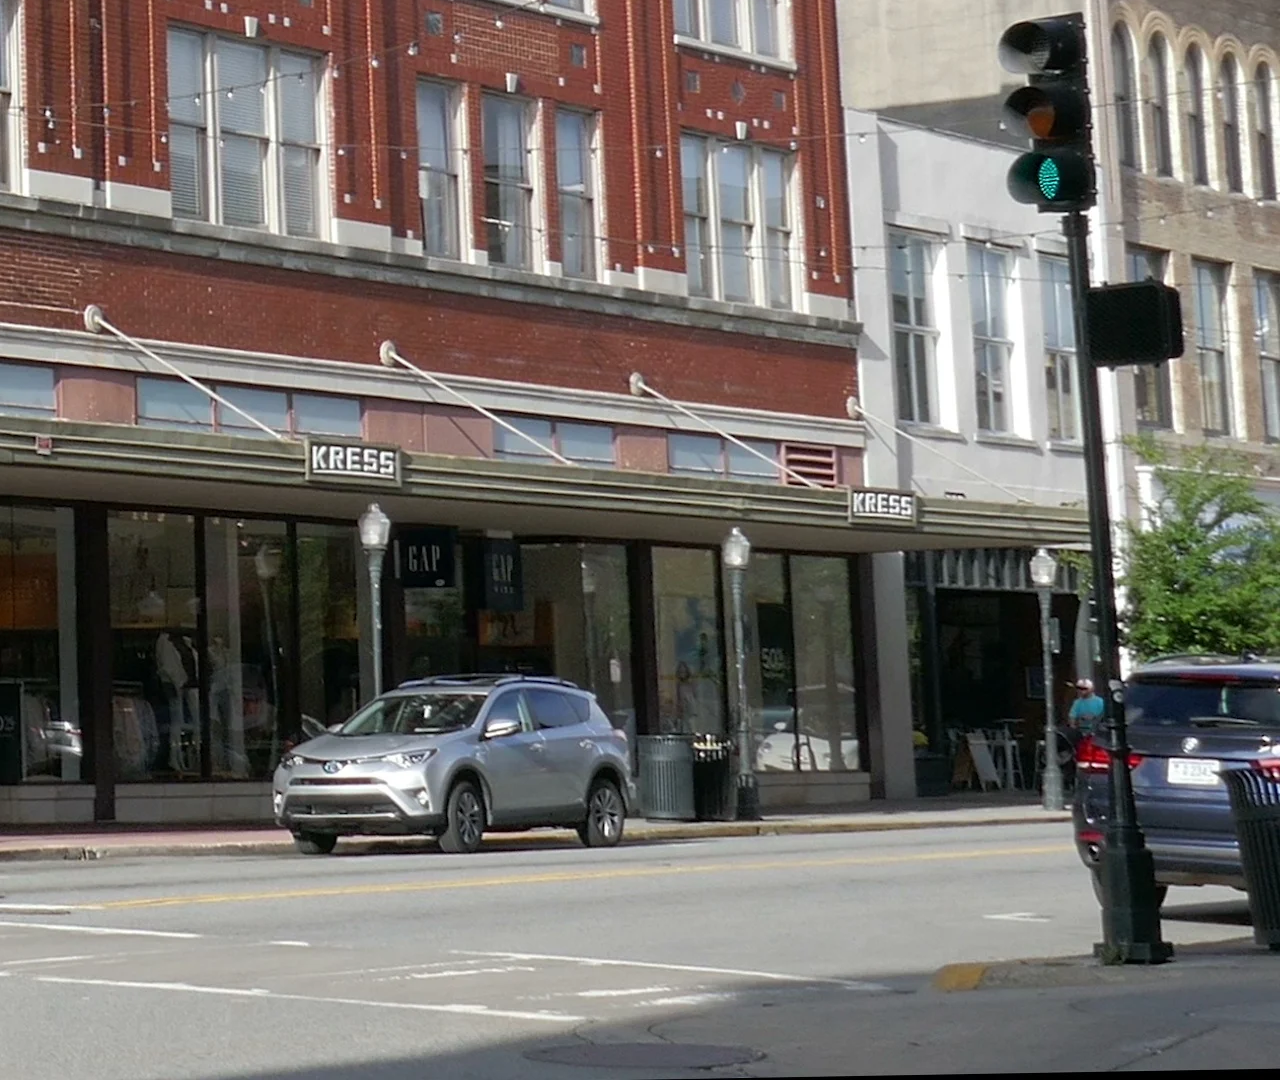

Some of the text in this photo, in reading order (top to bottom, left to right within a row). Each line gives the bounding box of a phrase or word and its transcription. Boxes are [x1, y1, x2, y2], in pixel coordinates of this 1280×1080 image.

[312, 445, 395, 474] KRESS
[853, 492, 912, 516] KRESS
[408, 544, 440, 573] GAP
